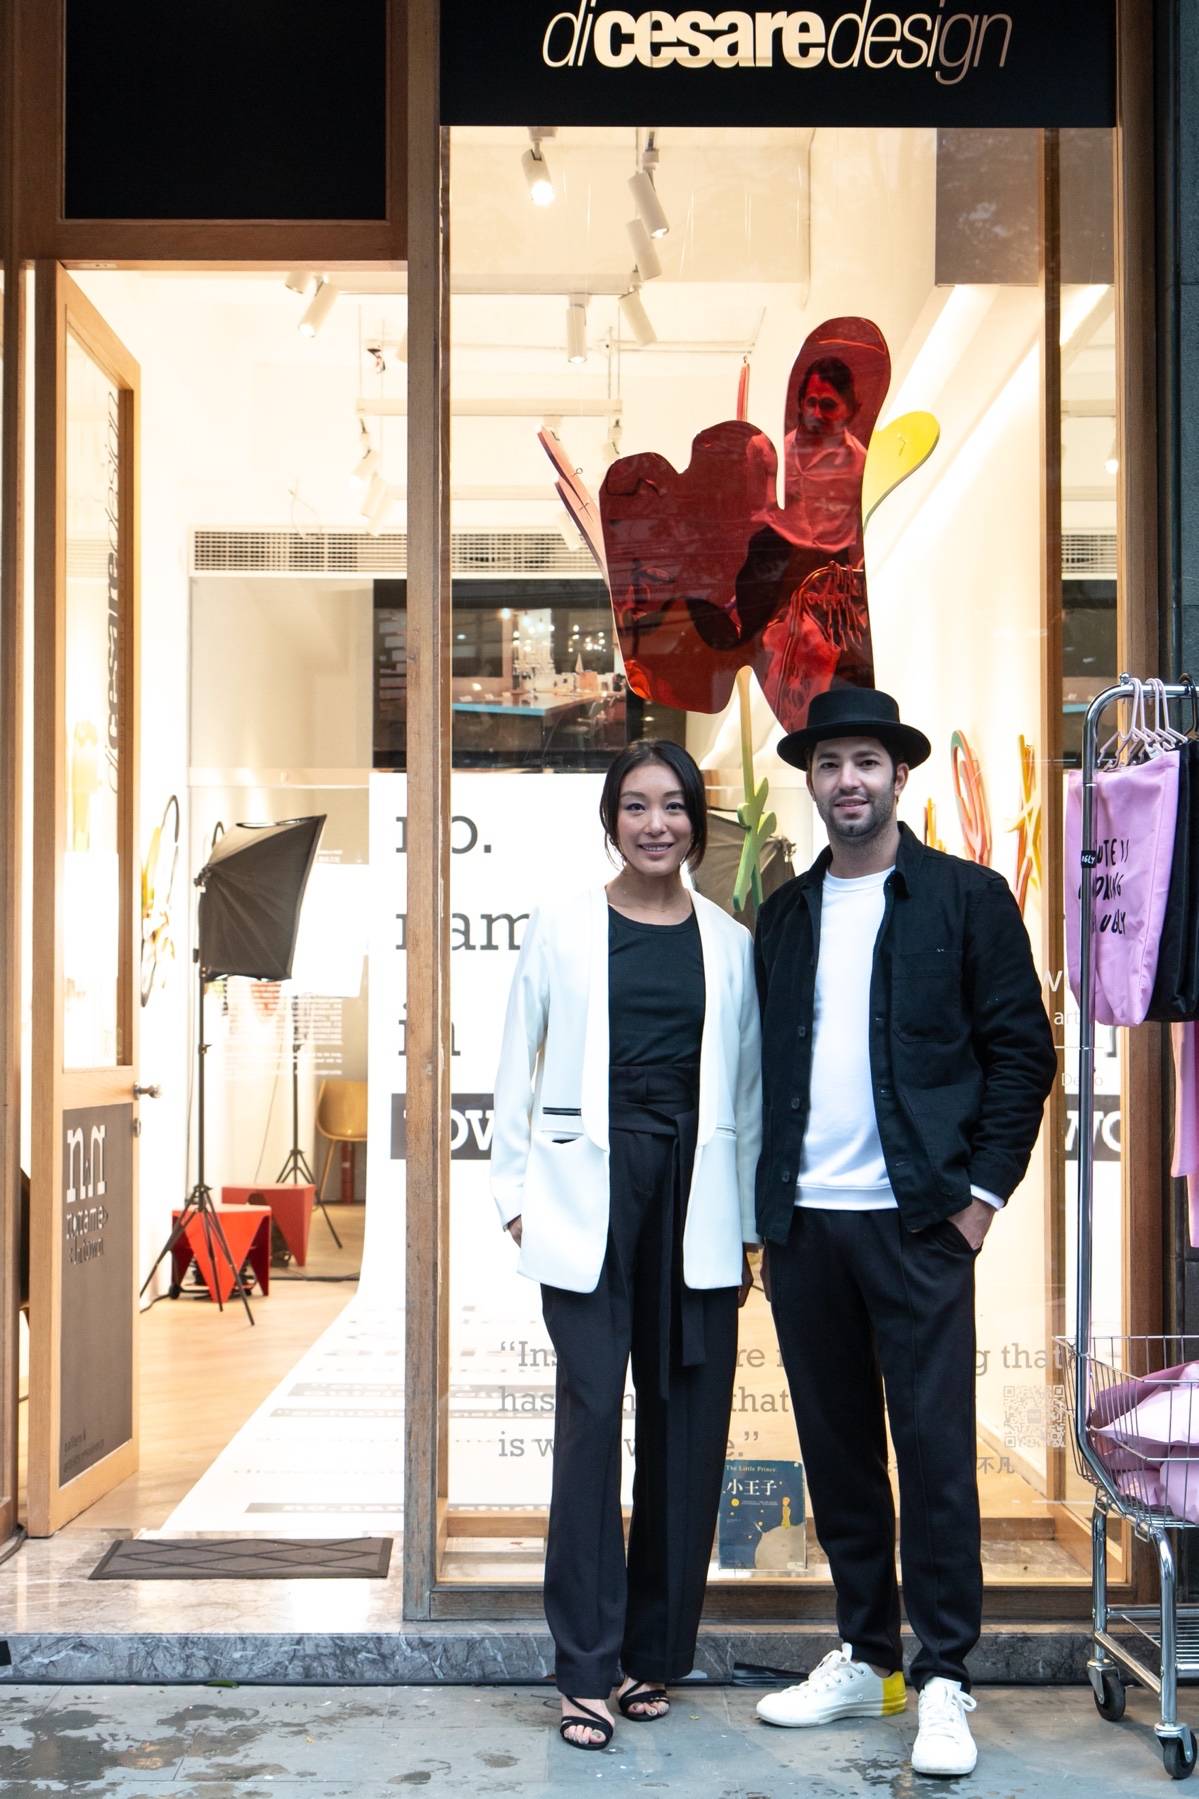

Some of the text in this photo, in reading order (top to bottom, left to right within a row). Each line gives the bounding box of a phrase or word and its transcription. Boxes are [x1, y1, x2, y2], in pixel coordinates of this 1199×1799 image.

[498, 1431, 525, 1457] is
[726, 1478, 777, 1496] 小王子
